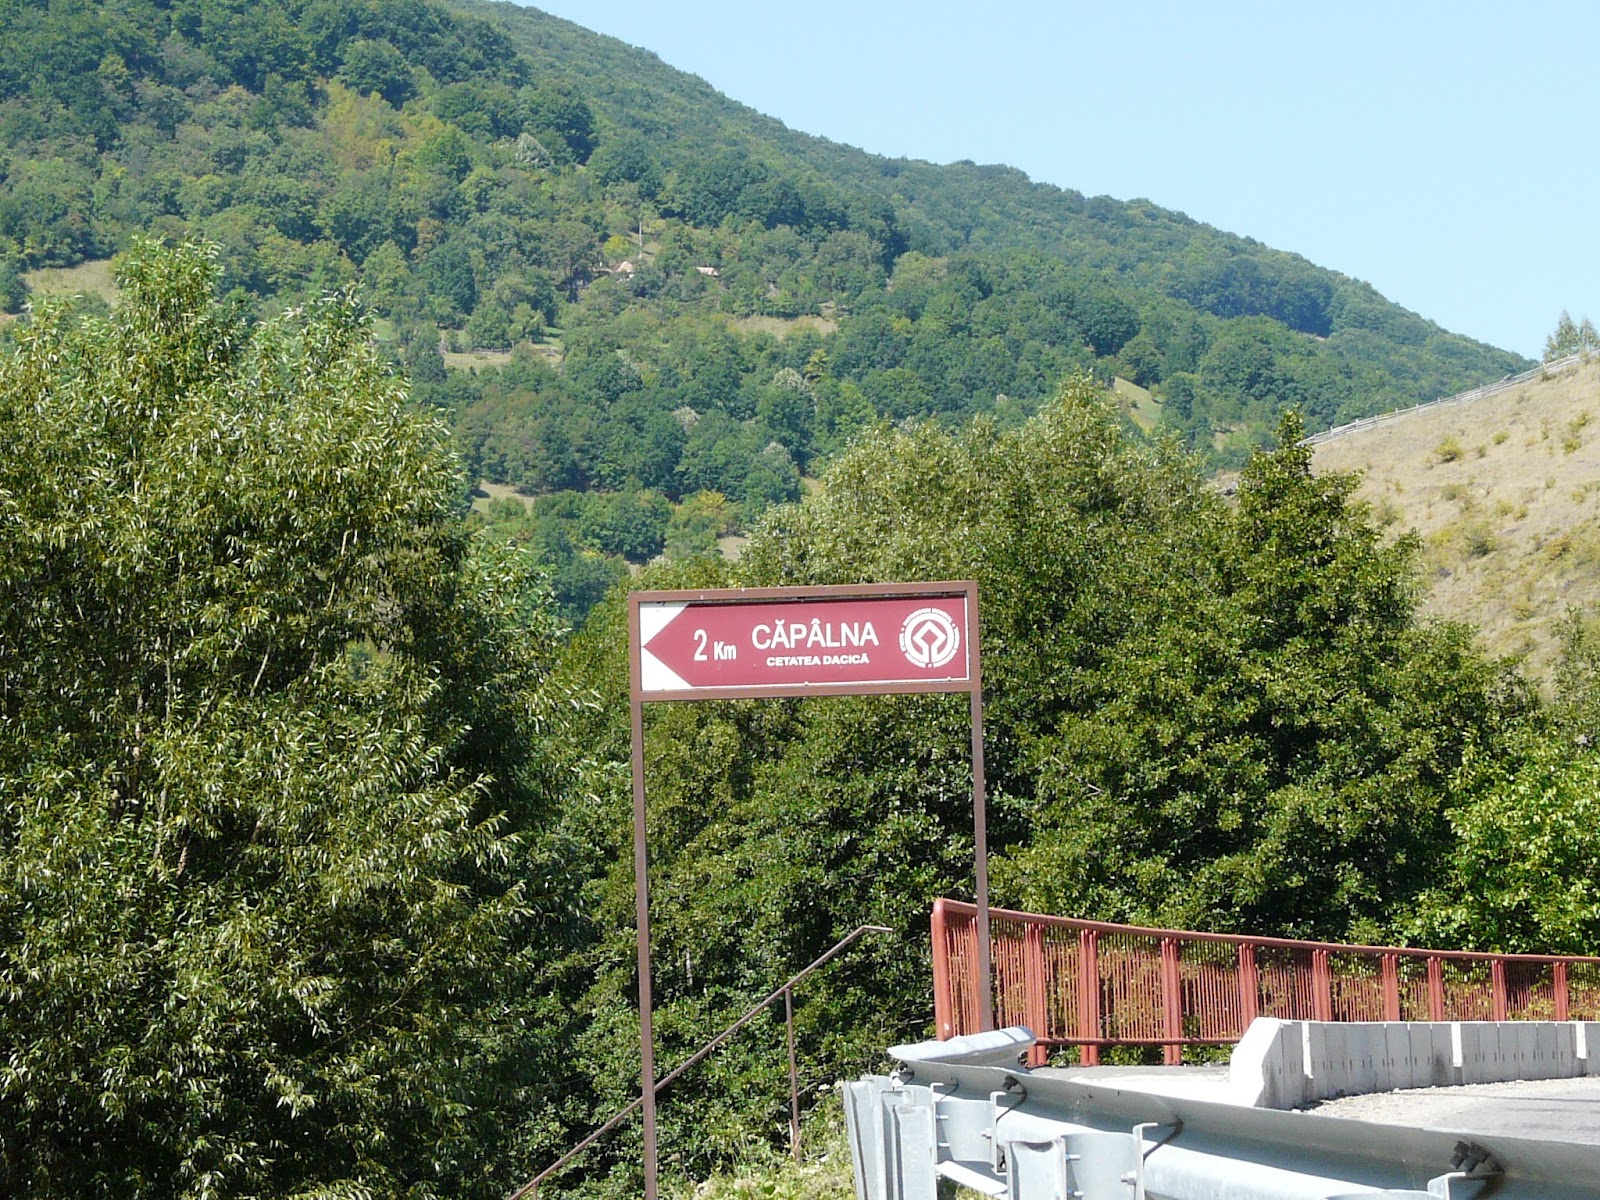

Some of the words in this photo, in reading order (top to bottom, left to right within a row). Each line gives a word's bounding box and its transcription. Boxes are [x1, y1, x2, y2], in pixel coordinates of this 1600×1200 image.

[693, 628, 708, 662] 2
[713, 640, 738, 661] Km
[751, 617, 880, 650] CĂPÂLNA
[765, 655, 821, 667] CETATEA
